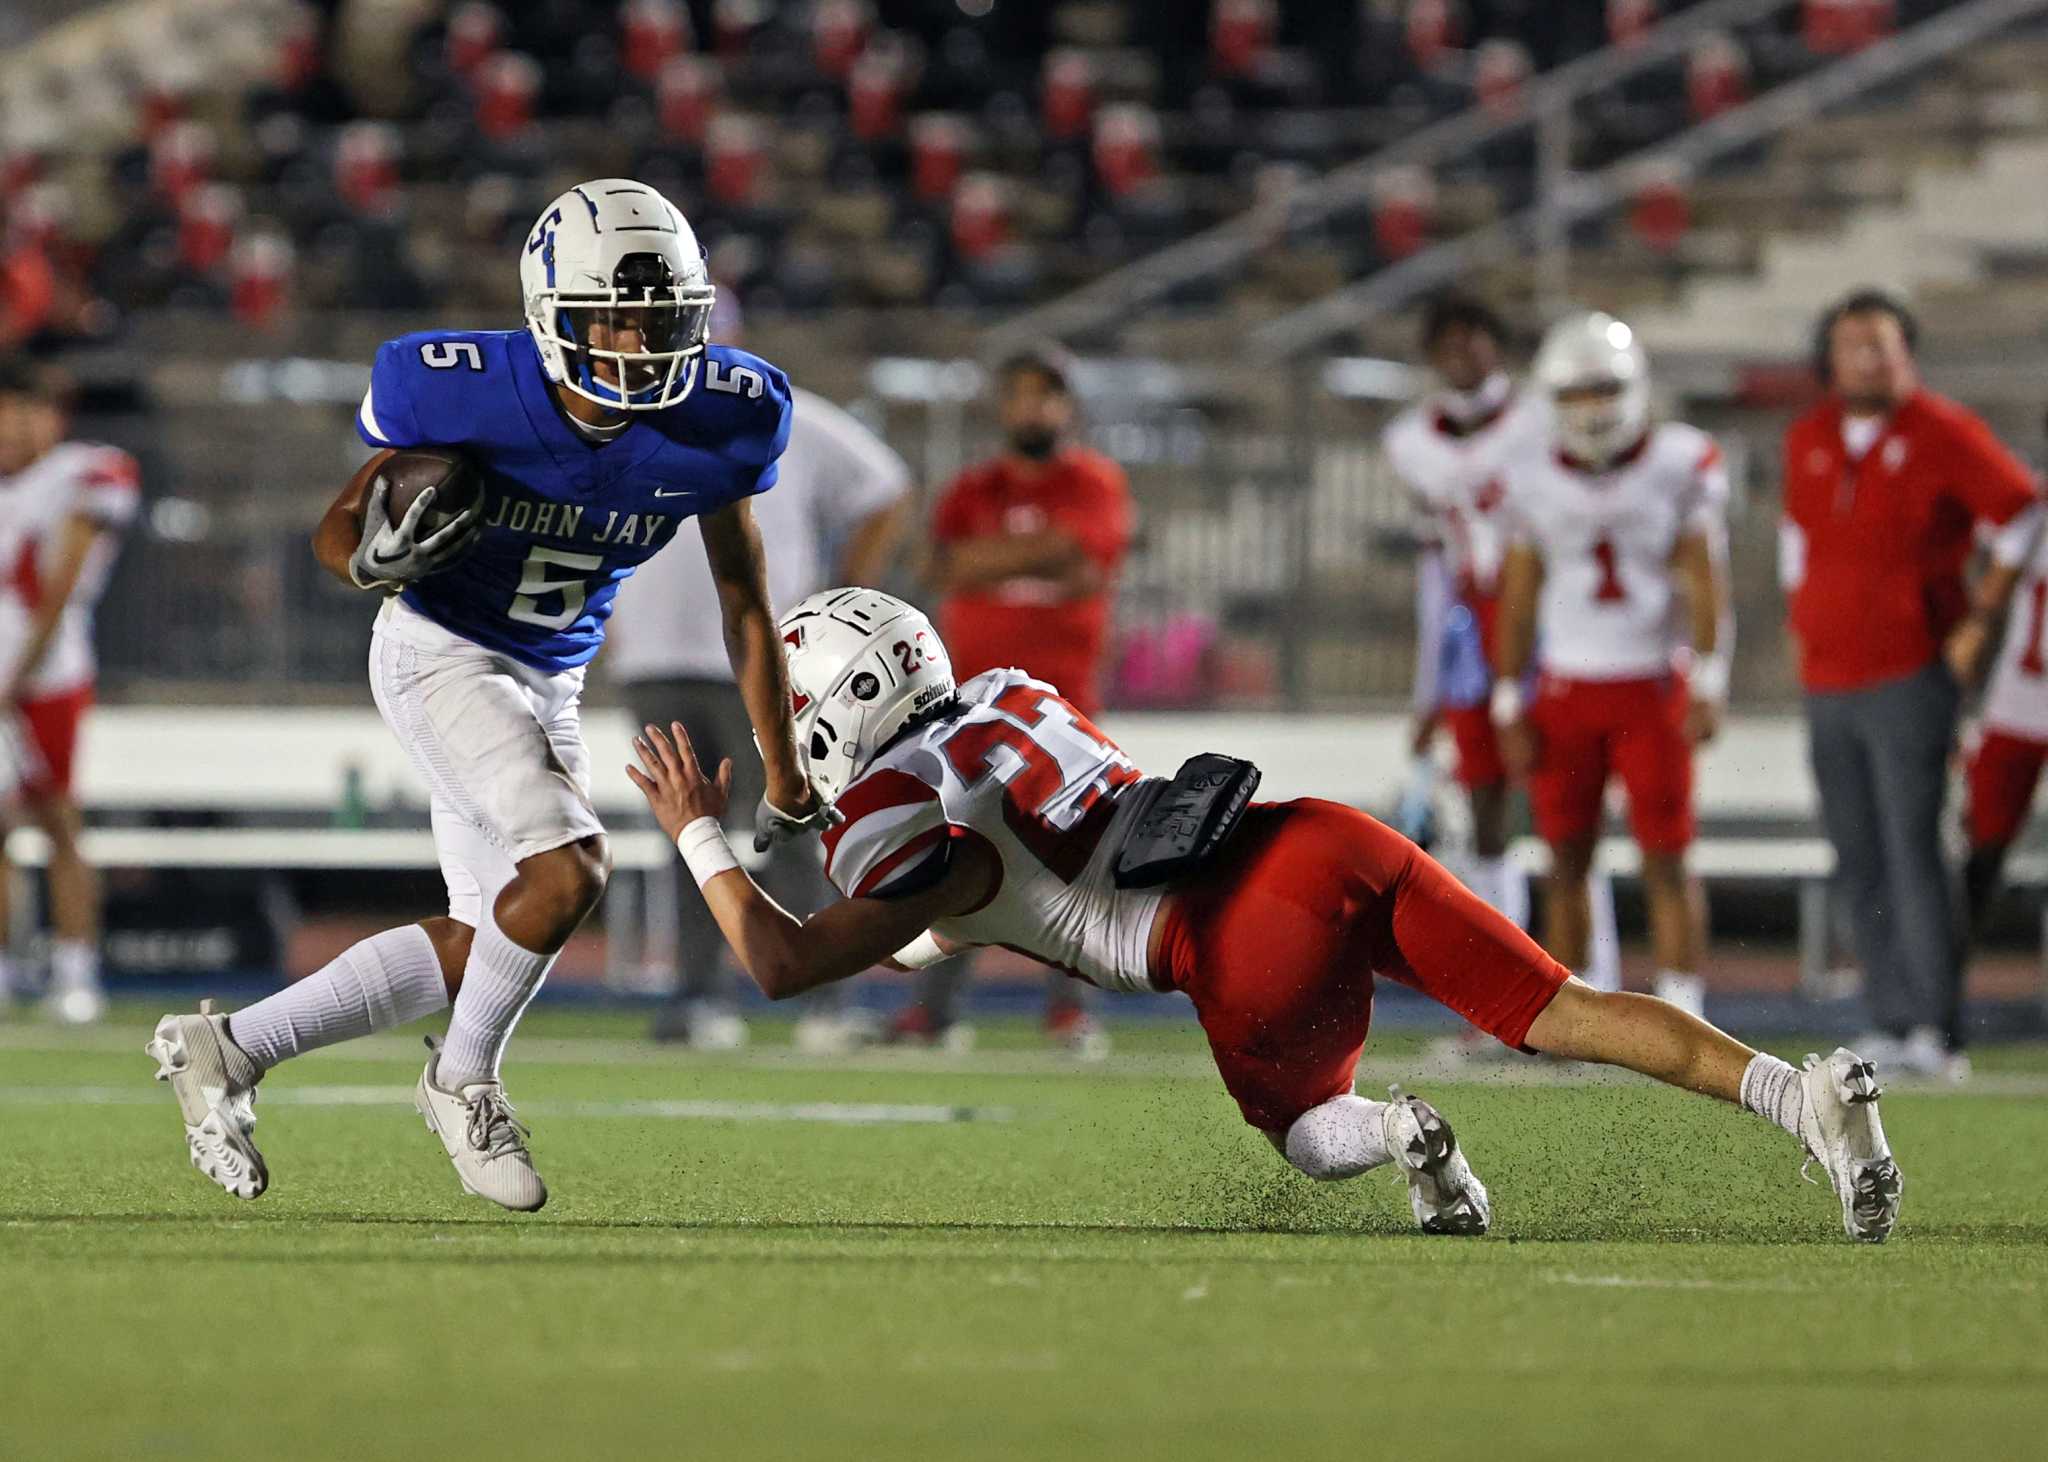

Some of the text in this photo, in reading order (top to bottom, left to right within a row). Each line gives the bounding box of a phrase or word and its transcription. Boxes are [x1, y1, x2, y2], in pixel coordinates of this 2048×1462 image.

[421, 340, 482, 372] 5
[705, 360, 764, 399] 5
[486, 496, 666, 546] JOHN JAY
[507, 545, 604, 632] 5
[1591, 526, 1627, 604] 1
